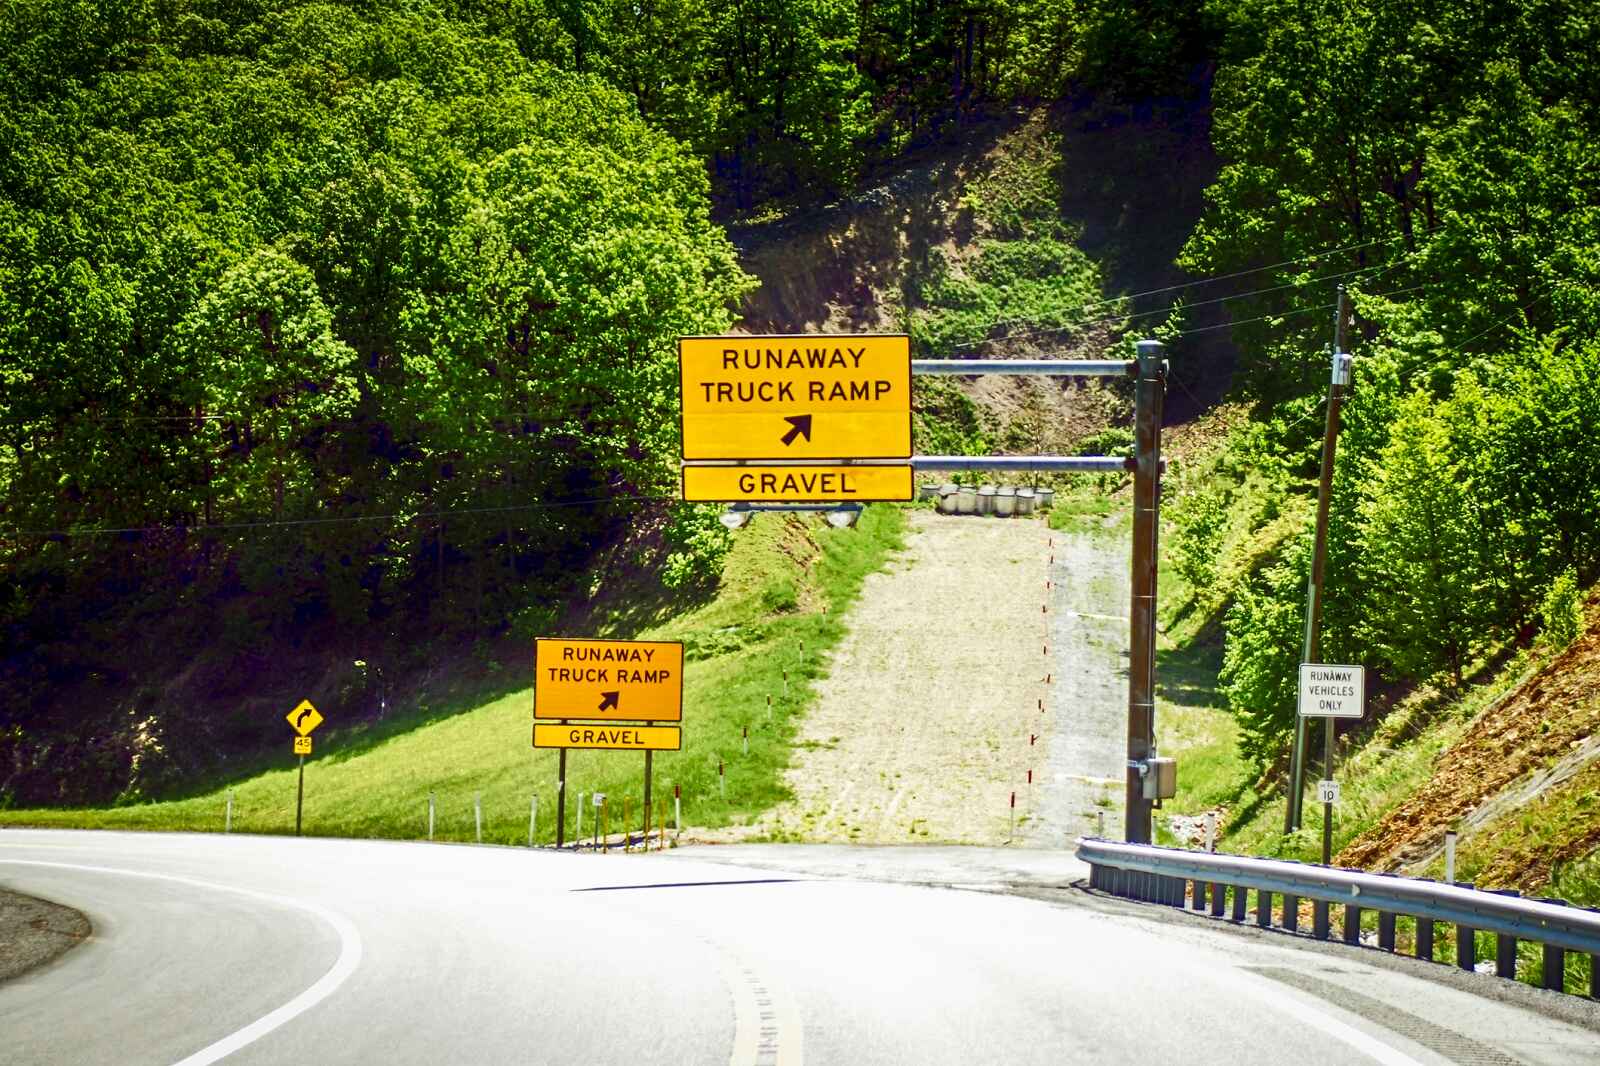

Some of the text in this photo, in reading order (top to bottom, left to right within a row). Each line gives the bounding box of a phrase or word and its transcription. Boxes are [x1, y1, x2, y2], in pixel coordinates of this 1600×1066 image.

[723, 348, 866, 369] RUNAWAY
[700, 380, 892, 402] TRUCK RAMP
[738, 473, 857, 494] GRAVEL
[563, 647, 655, 662] RUNAWAY
[548, 668, 670, 683] TRUCK RAMP
[1310, 671, 1352, 682] RUNAWAY
[1309, 686, 1354, 696] VEHICLES
[1319, 700, 1342, 710] ONLY
[296, 739, 310, 747] 45
[569, 730, 645, 745] GRAVEL
